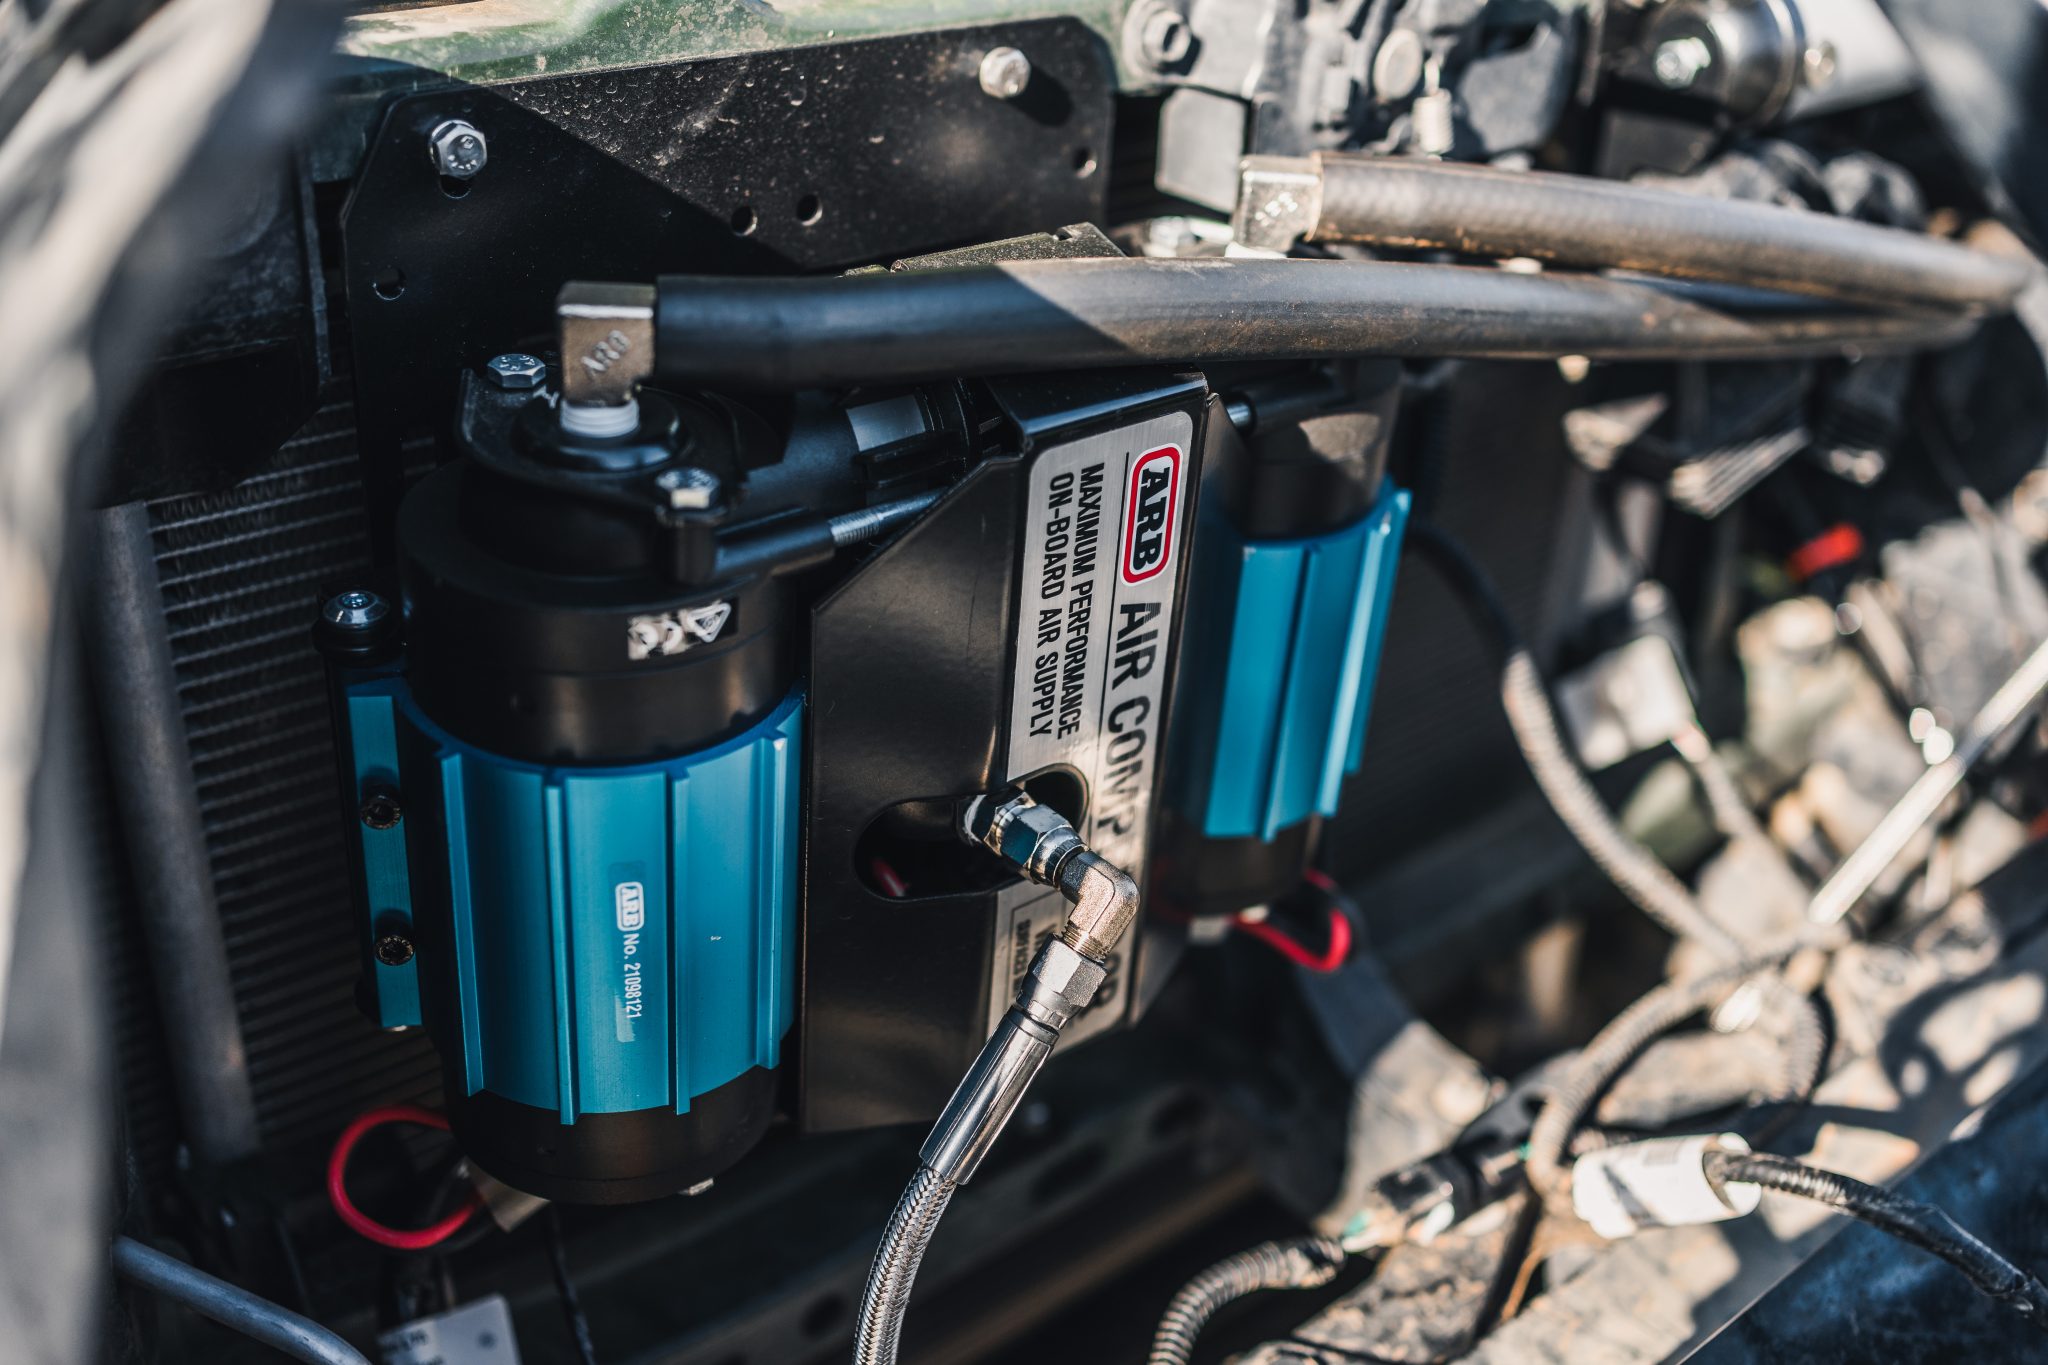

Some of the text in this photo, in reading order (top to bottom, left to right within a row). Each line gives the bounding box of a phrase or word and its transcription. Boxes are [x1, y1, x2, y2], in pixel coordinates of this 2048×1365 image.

[1132, 465, 1171, 571] ARB
[1029, 471, 1075, 738] ON-BOARD AIR SUPPLY
[1056, 462, 1105, 740] MAXIMUM PERFORMANCE
[1111, 602, 1162, 691] AIR
[619, 884, 643, 1019] ARB No. 21098121
